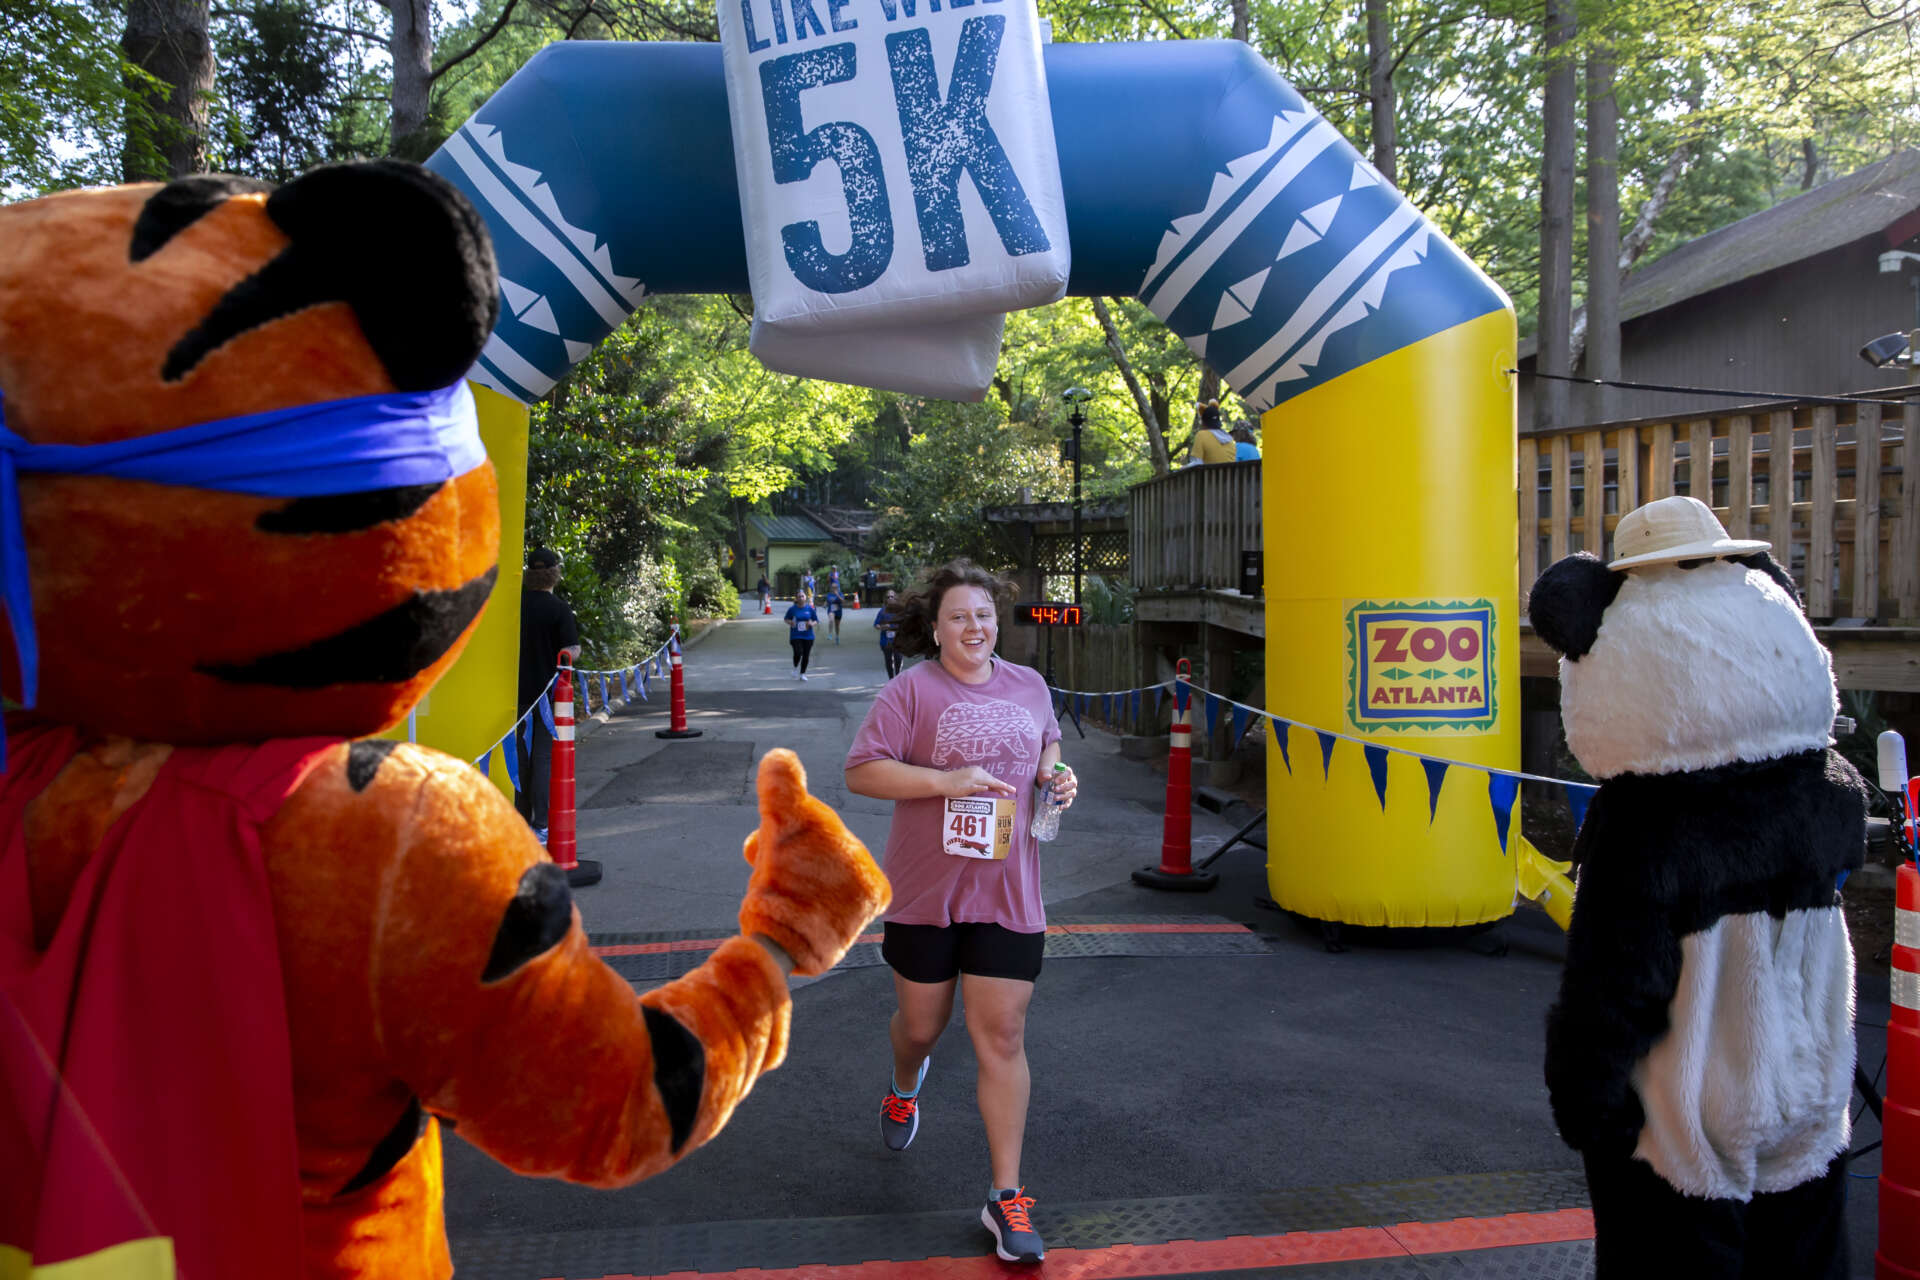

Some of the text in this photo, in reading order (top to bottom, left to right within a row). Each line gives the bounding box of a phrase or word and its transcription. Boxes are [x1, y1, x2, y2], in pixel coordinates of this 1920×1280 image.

[741, 0, 858, 53] LIKE
[759, 15, 1051, 294] 5K
[1032, 607, 1080, 625] 44:17
[1373, 627, 1480, 663] ZOO
[1371, 686, 1483, 705] ATLANTA
[950, 814, 987, 837] 461
